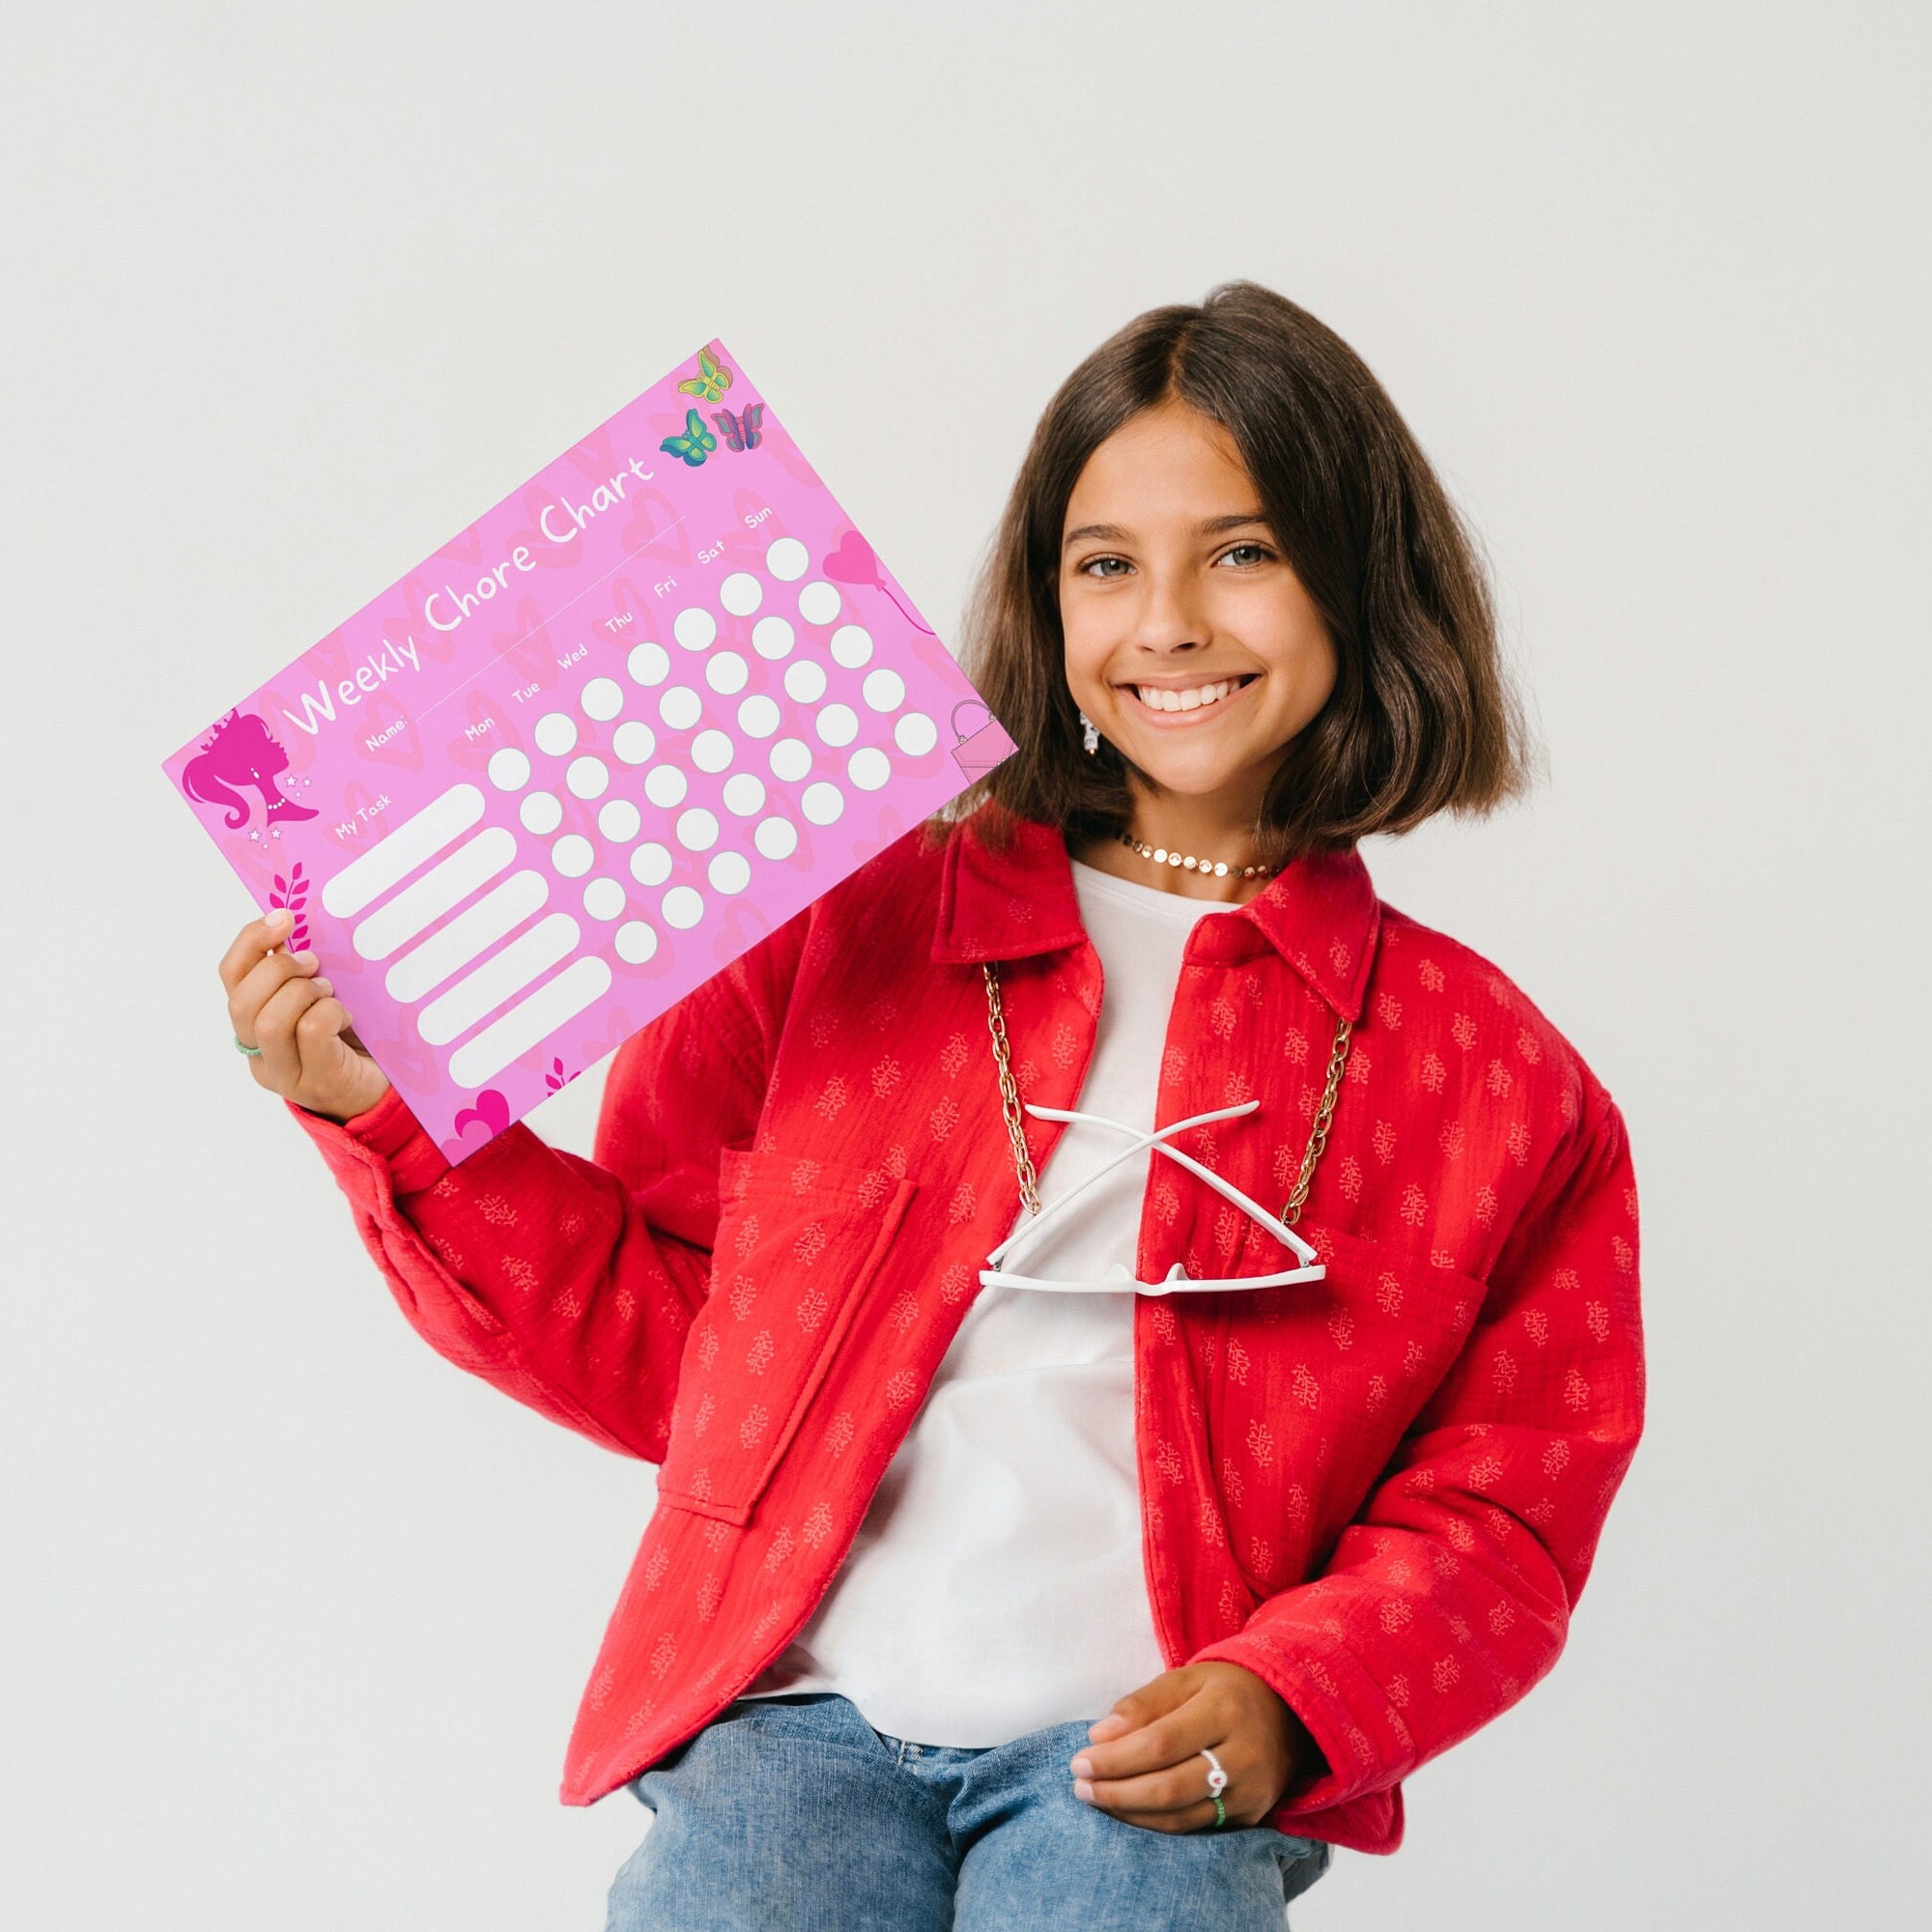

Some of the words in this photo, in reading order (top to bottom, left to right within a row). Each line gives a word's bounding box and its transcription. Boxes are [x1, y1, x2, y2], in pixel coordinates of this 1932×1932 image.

[282, 635, 420, 735] Weekly
[424, 546, 537, 632] Chore
[540, 457, 655, 543] Chart
[465, 717, 496, 741] Mon
[511, 681, 541, 704] Tue
[556, 643, 588, 669] Wed
[605, 611, 634, 633] Thu
[653, 575, 677, 598] Fri
[696, 540, 725, 565] Sat
[744, 507, 773, 529] Sun
[364, 714, 408, 752] Name:
[334, 820, 357, 840] My
[355, 793, 392, 822] Task
